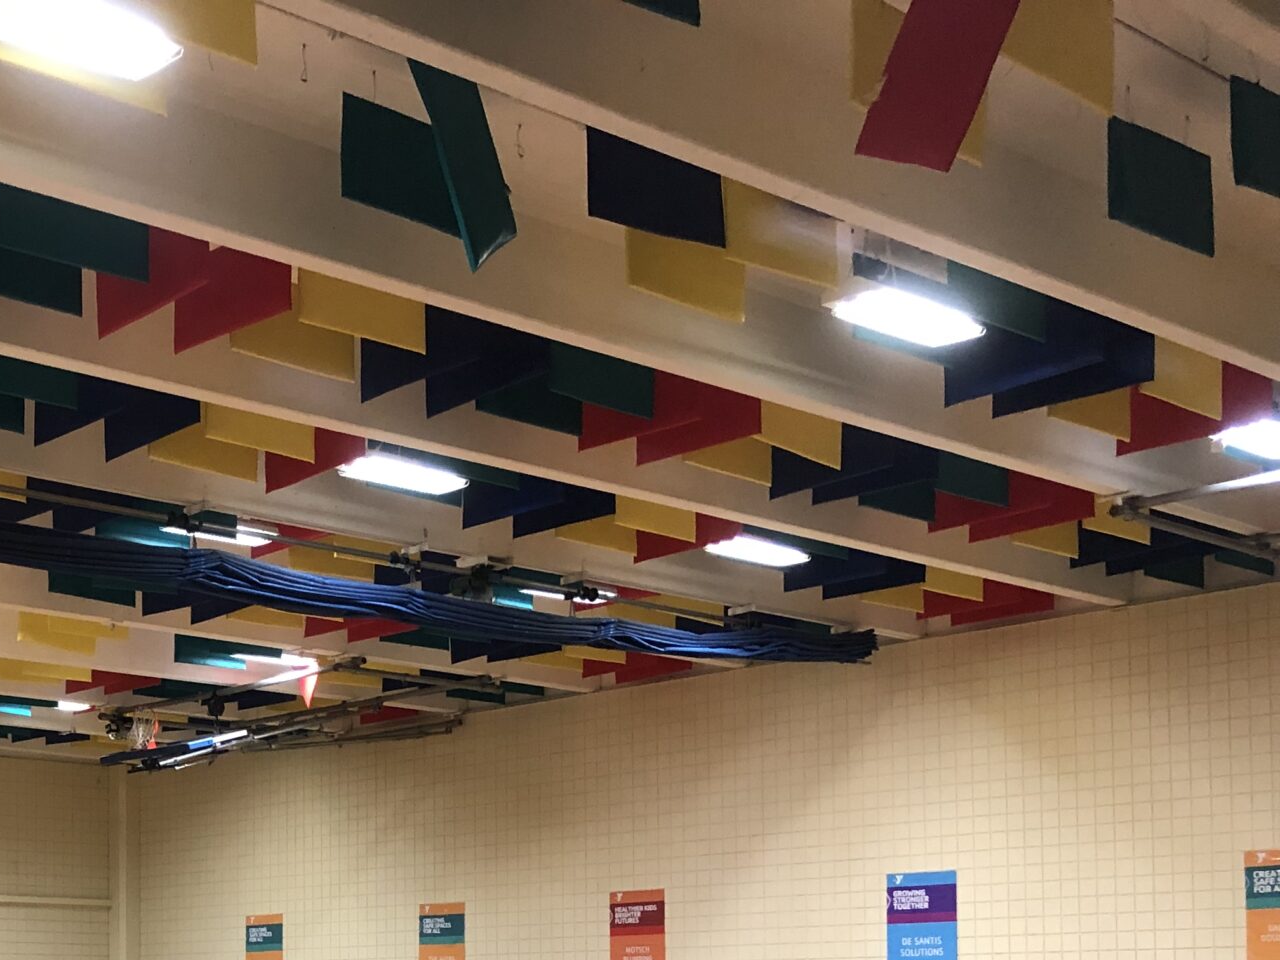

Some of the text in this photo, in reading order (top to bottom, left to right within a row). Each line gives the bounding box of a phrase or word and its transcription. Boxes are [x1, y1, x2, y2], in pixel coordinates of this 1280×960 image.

[1253, 870, 1280, 878] CREAT
[1254, 878, 1275, 886] SAFE
[893, 889, 926, 897] GROWING
[1254, 885, 1271, 893] FOR
[893, 902, 929, 910] TOGETHER
[902, 936, 942, 945] DE SANTIS
[900, 948, 944, 957] SOLUTIONS
